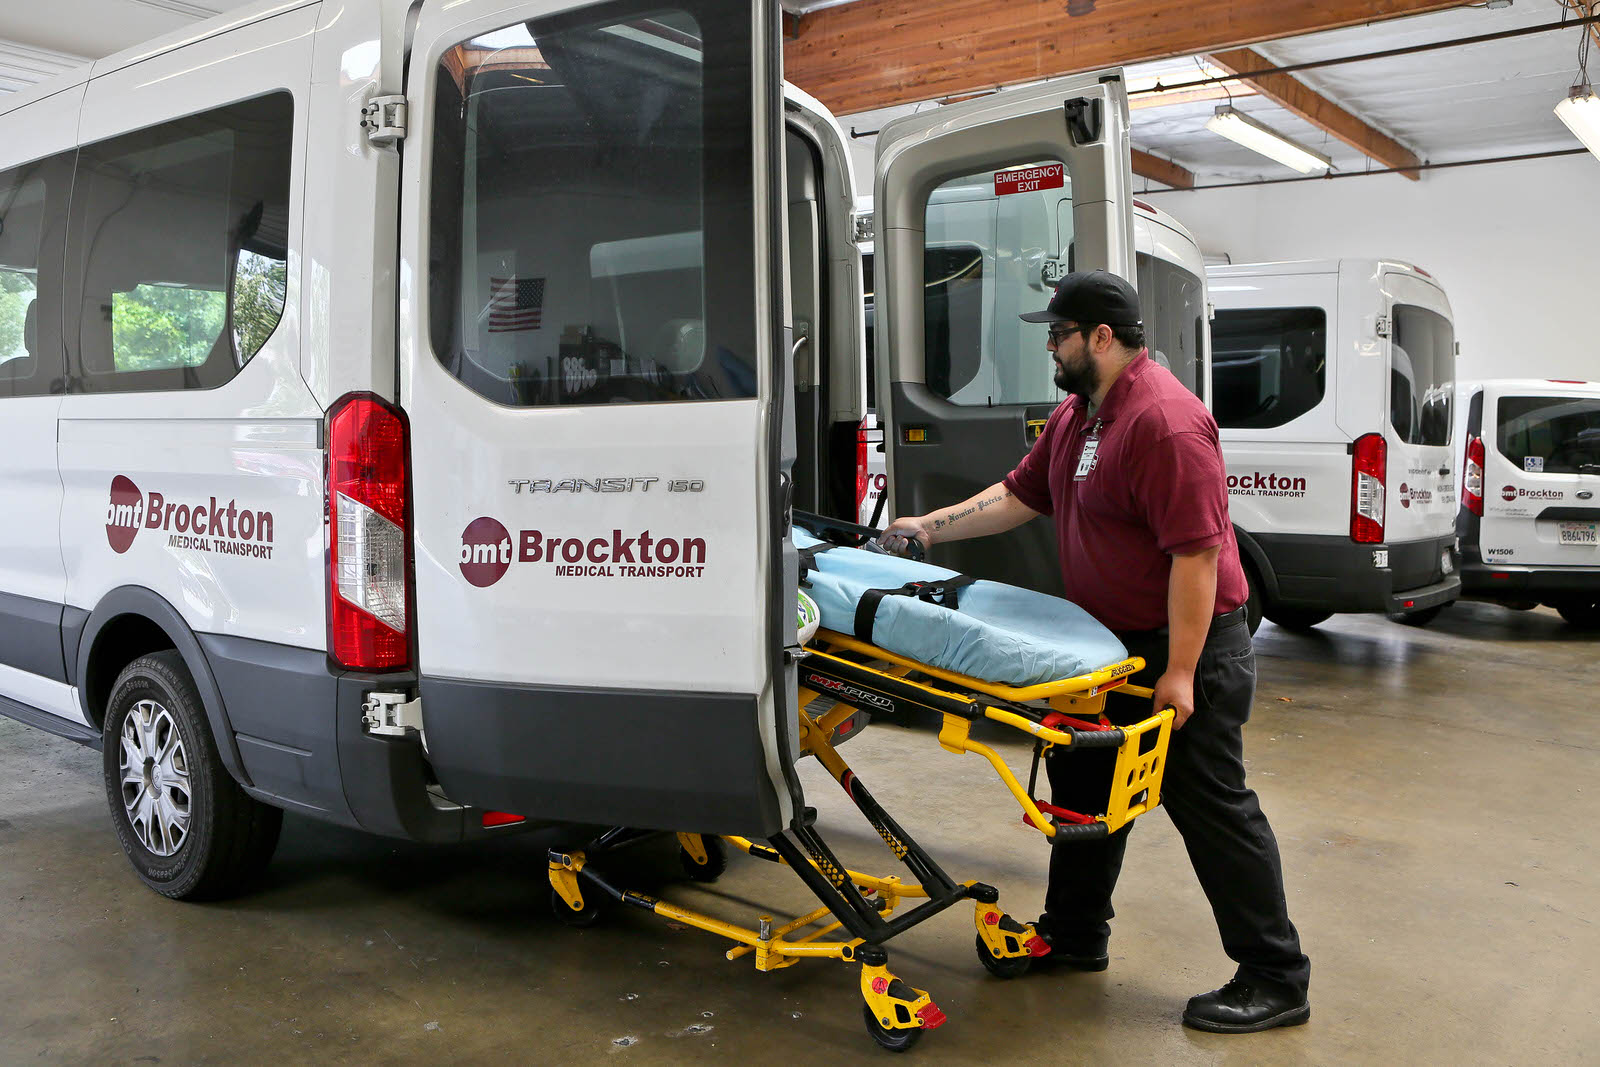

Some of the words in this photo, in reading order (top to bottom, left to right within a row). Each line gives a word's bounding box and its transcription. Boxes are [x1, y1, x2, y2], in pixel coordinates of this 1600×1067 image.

[996, 166, 1062, 184] EMERGENCY
[1017, 180, 1041, 192] EXIT
[508, 476, 659, 494] TRANSIT
[667, 479, 705, 493] 150
[1226, 472, 1306, 491] ockton
[1228, 488, 1256, 496] EDICAL
[1257, 490, 1306, 498] TRANSPORT
[1519, 488, 1564, 498] Brockton
[145, 491, 274, 543] Brockton
[934, 519, 946, 531] In
[947, 507, 976, 526] Nomine
[977, 495, 1003, 511] Patris
[168, 534, 211, 552] MEDICAL
[213, 539, 273, 560] TRANSPORT
[518, 529, 707, 564] Brockton
[1487, 548, 1514, 556] W1506
[555, 565, 614, 577] MEDICAL
[619, 566, 705, 578] TRANSPORT
[809, 673, 891, 707] MX-PRO
